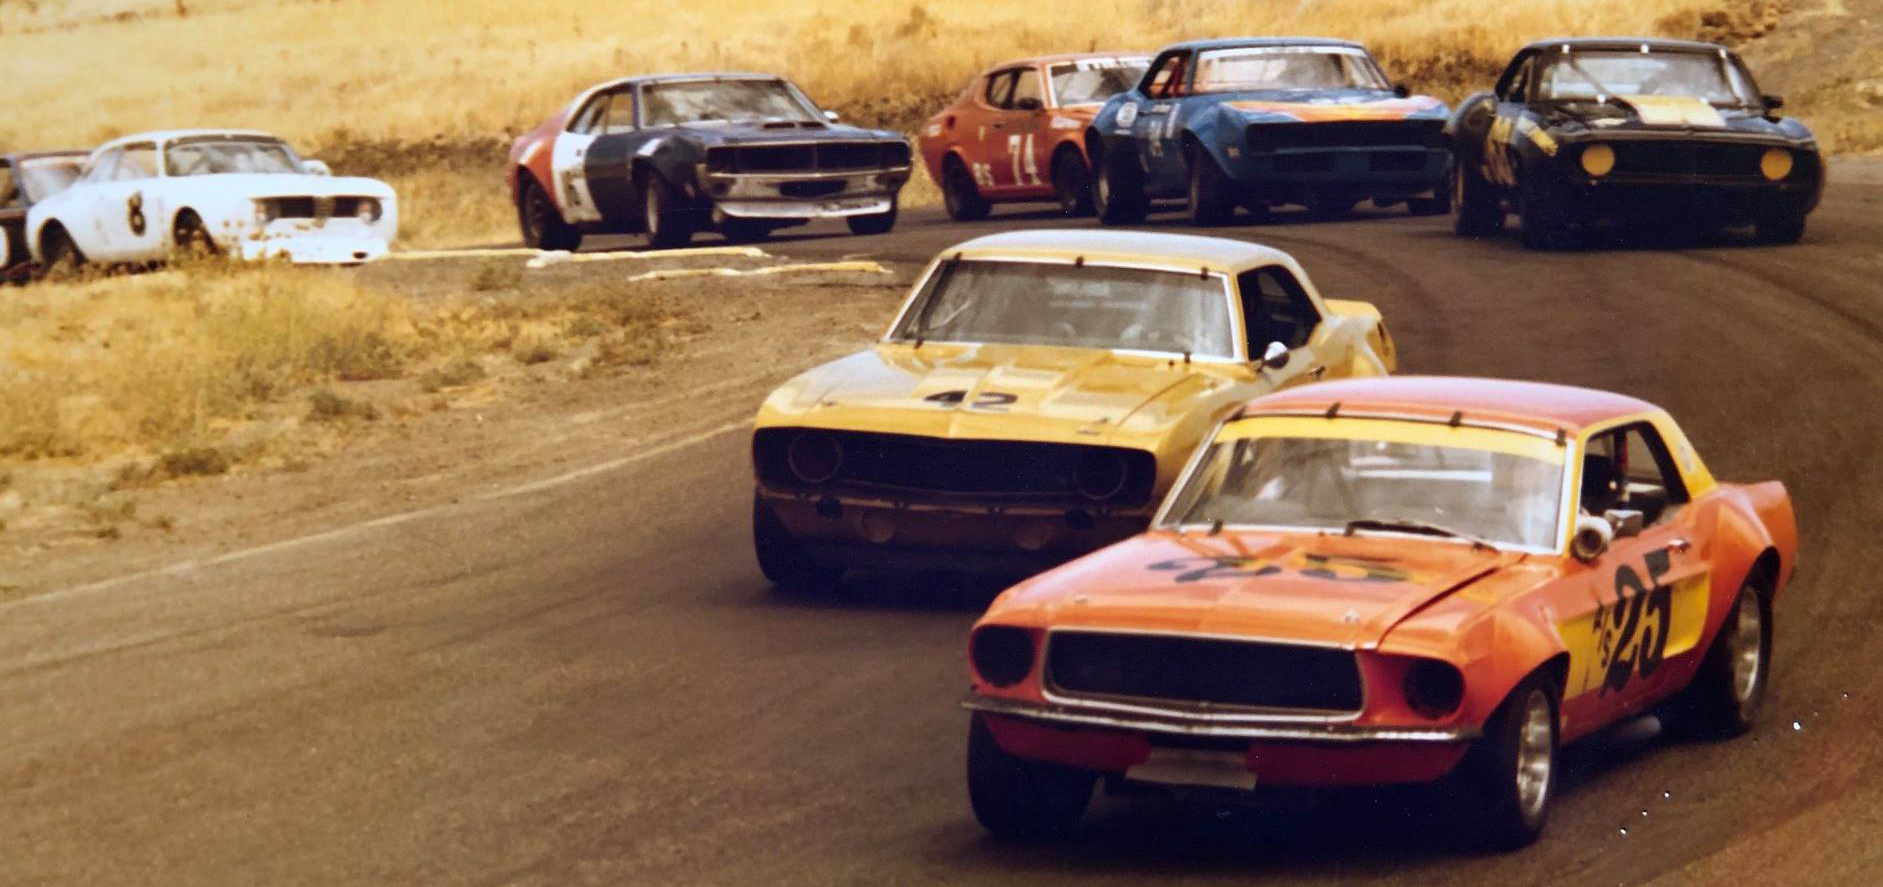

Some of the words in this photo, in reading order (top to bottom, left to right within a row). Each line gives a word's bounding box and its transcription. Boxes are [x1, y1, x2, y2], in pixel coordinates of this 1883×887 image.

[1008, 132, 1041, 186] 74
[127, 189, 146, 236] 8
[924, 390, 1018, 412] 42
[1147, 553, 1408, 583] 25
[1600, 549, 1671, 696] 25
